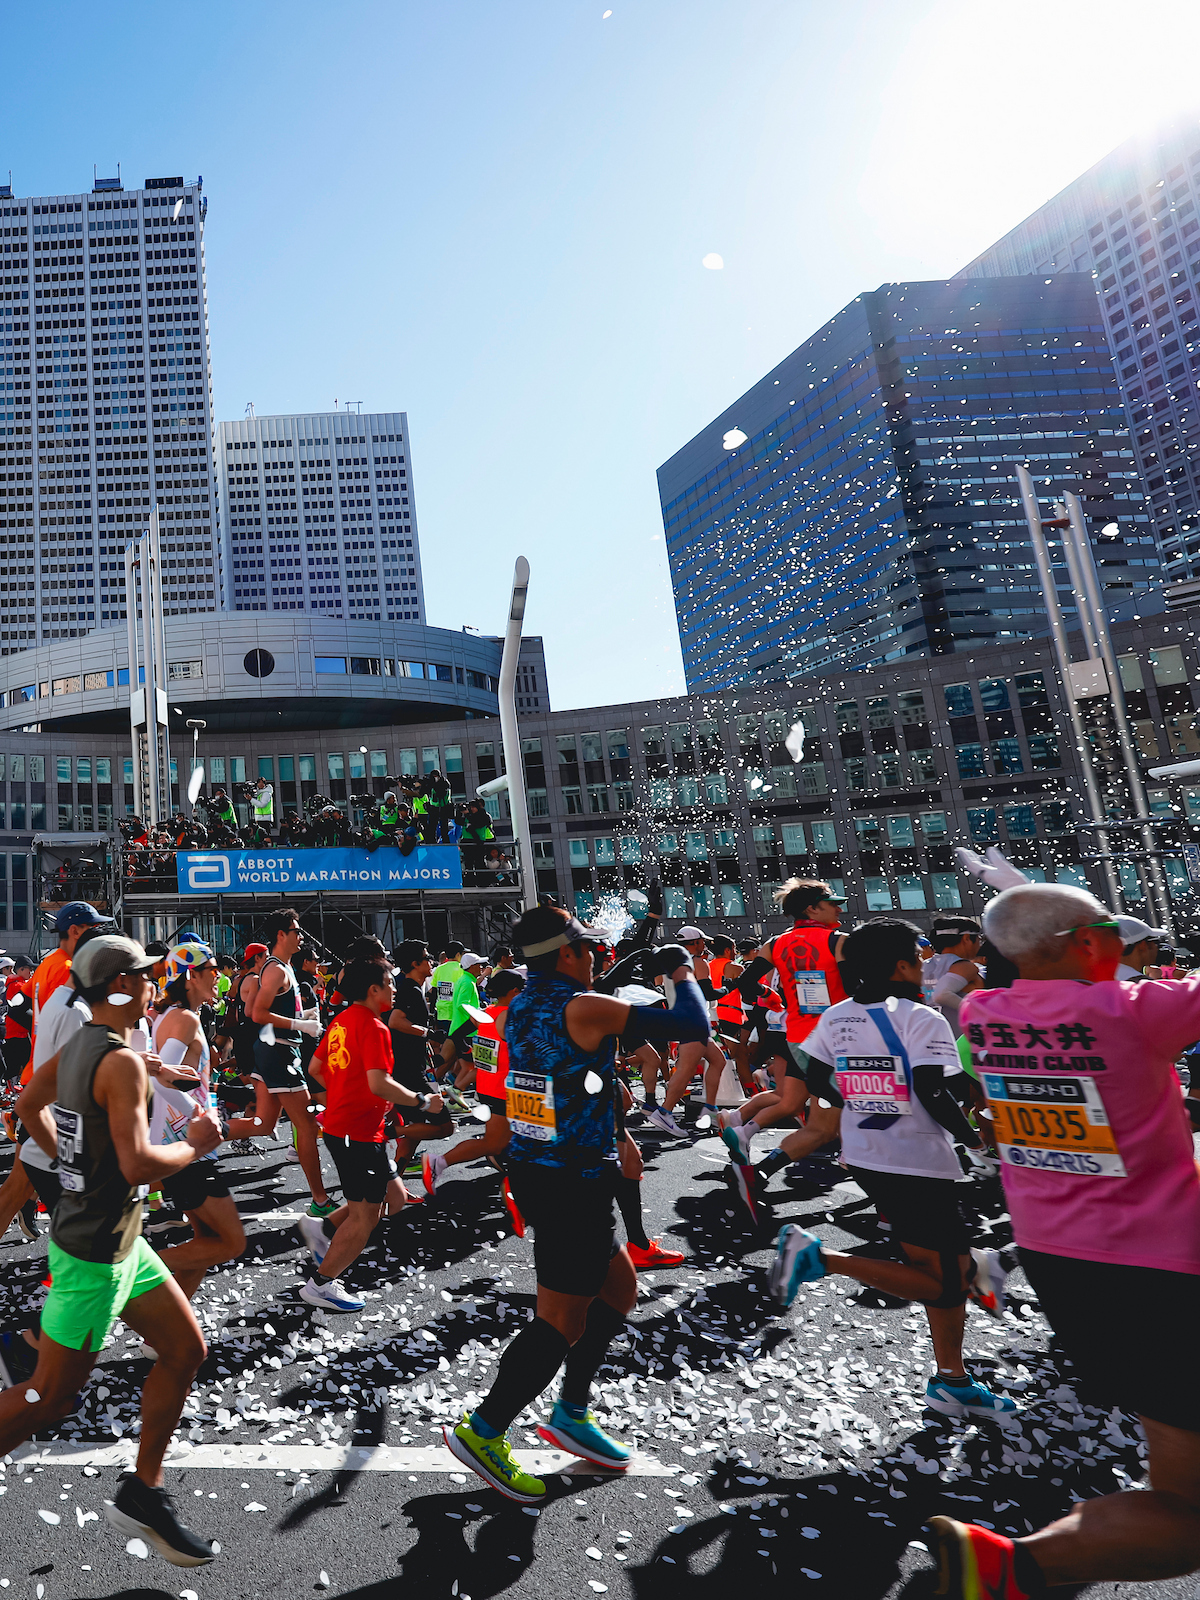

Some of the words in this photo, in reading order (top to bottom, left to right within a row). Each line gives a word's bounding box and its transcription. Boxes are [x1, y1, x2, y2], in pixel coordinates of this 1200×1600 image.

[237, 858, 294, 870] ABBOTT
[238, 872, 290, 882] WORLD
[296, 870, 381, 881] MARATHON
[389, 868, 451, 880] MAJORS
[1043, 1055, 1108, 1071] CLUB
[843, 1074, 895, 1094] 70006
[1006, 1082, 1079, 1097] 東京メトロ
[511, 1092, 545, 1118] 10322
[853, 1100, 899, 1113] STARTS
[1004, 1105, 1087, 1141] 10335
[1026, 1149, 1103, 1173] STARTS
[480, 1444, 513, 1480] HOKA
